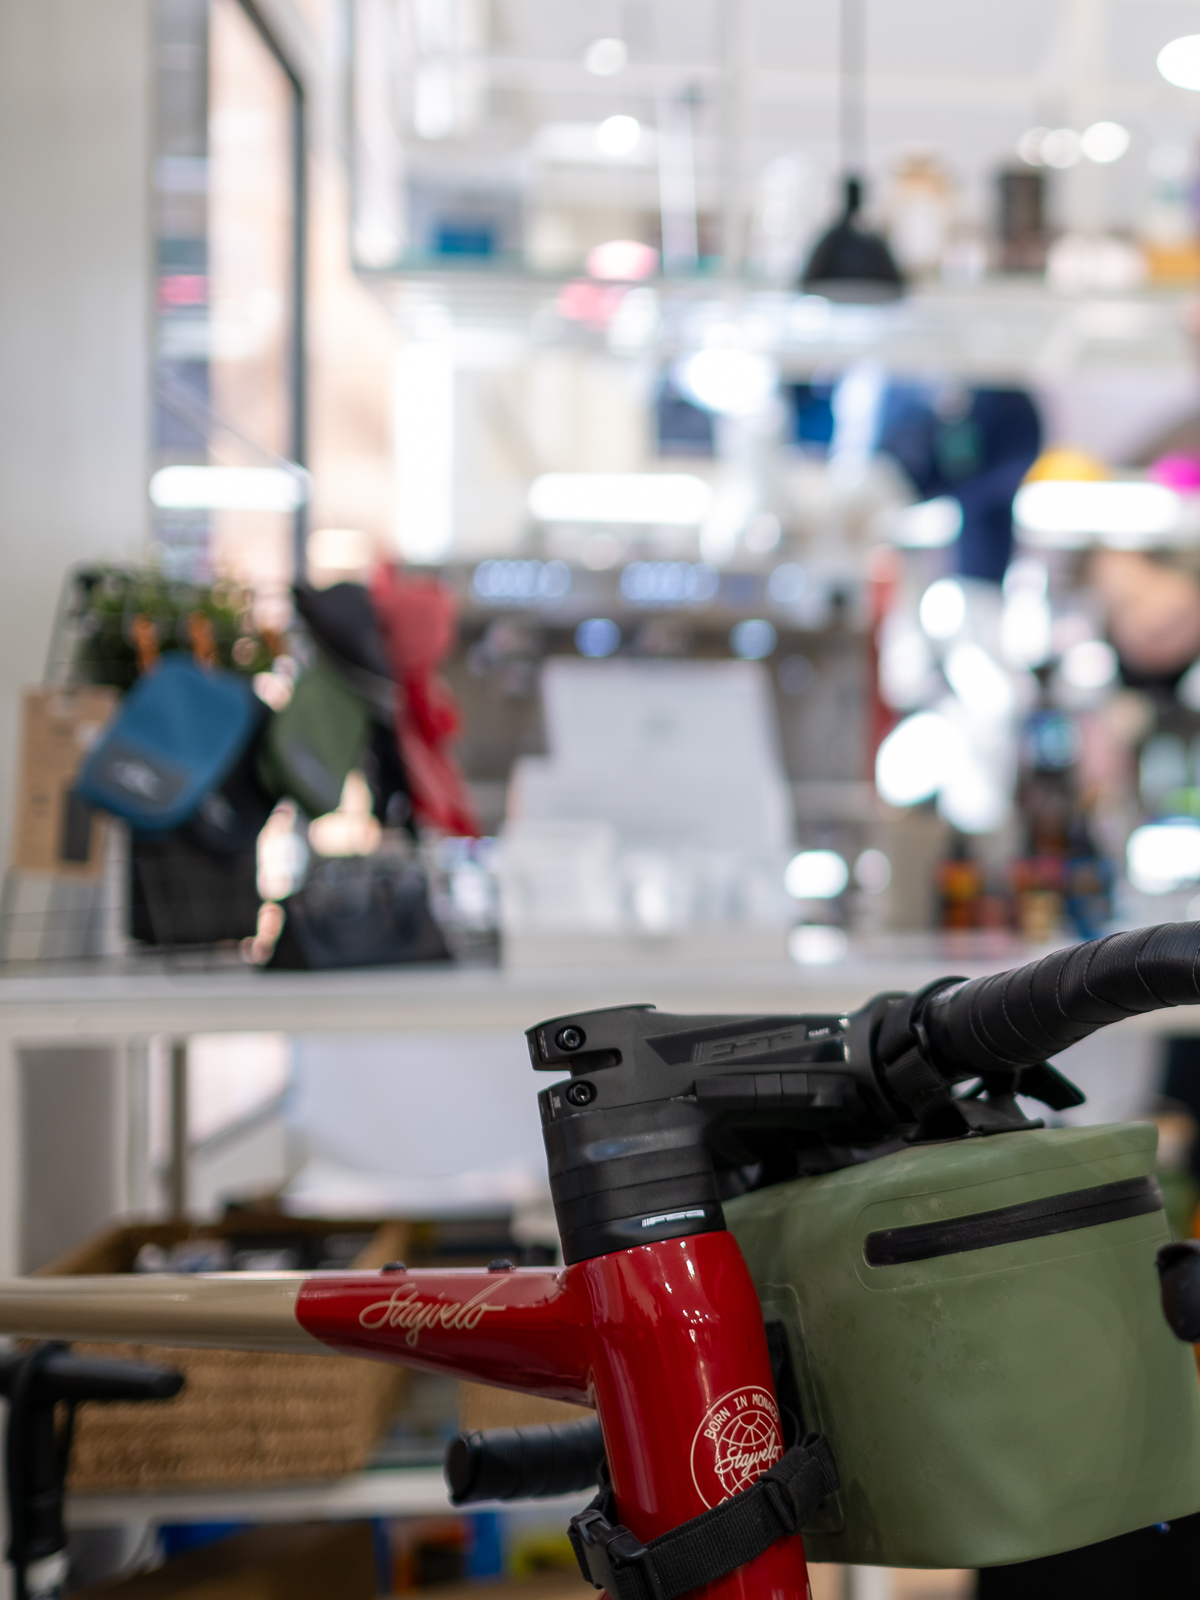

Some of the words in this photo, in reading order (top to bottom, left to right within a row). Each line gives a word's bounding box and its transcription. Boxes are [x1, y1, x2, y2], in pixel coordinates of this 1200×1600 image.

[703, 1406, 732, 1440] BORN
[732, 1394, 748, 1411] IN
[751, 1393, 779, 1423] MONACO
[714, 1431, 783, 1477] Stajvelo
